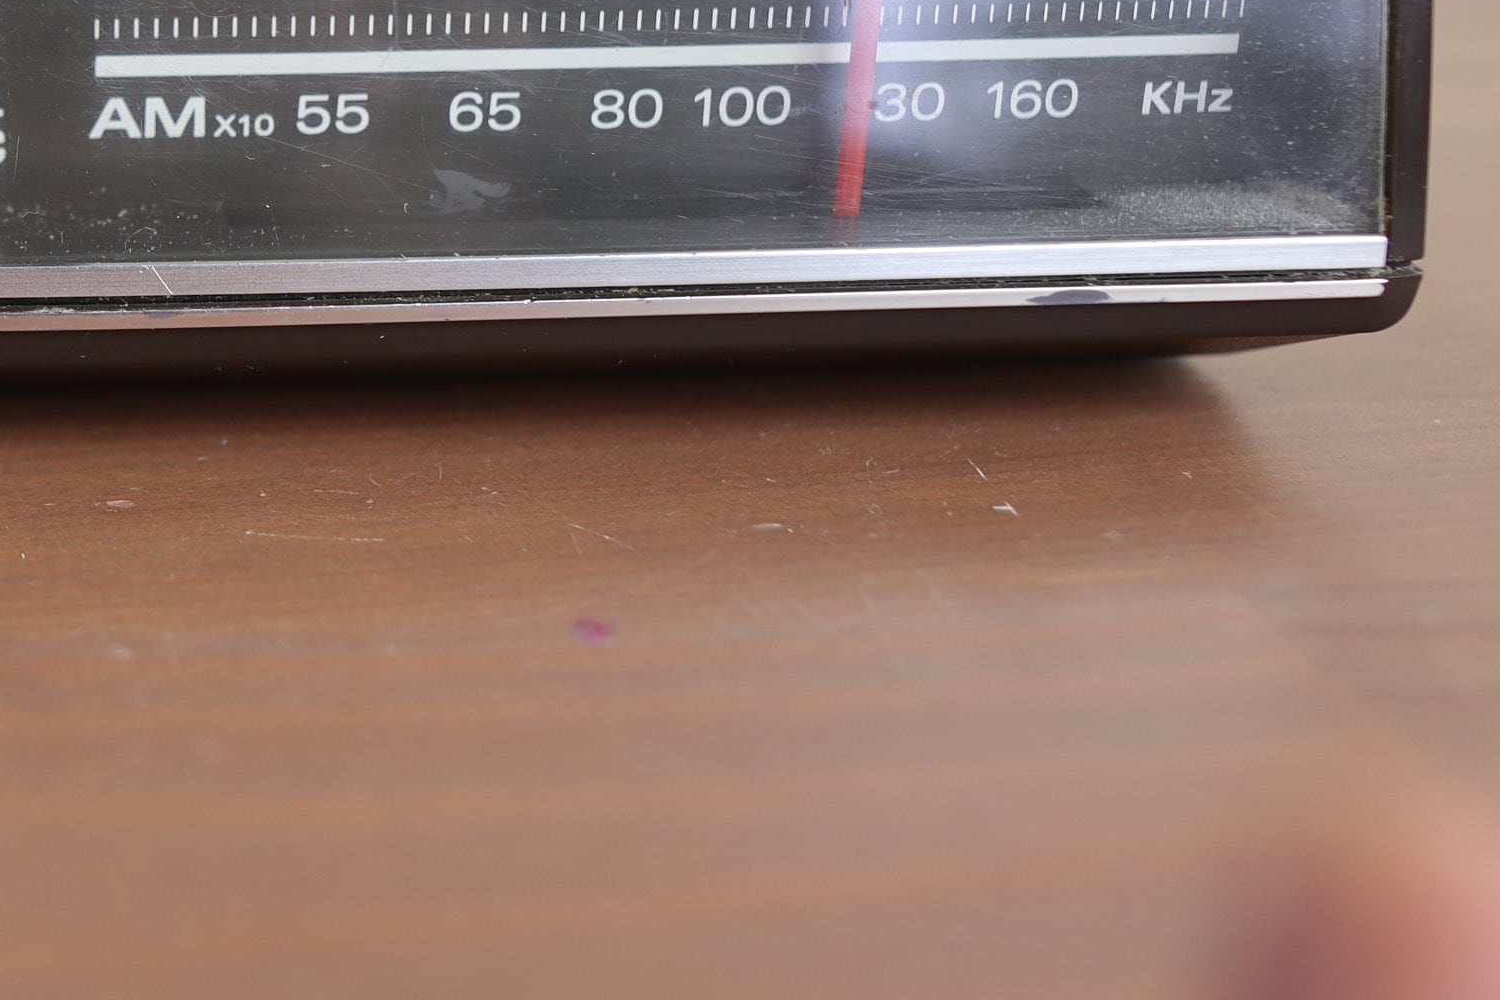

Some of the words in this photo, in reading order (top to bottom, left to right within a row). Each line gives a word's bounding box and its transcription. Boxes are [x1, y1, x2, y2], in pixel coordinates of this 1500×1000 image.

[89, 96, 206, 139] AM
[296, 94, 370, 135] 55
[449, 92, 522, 132] 65
[590, 88, 664, 130] 80
[693, 86, 792, 127] 100
[873, 82, 946, 122] 30
[987, 79, 1078, 119] 160
[1141, 81, 1233, 115] KHz
